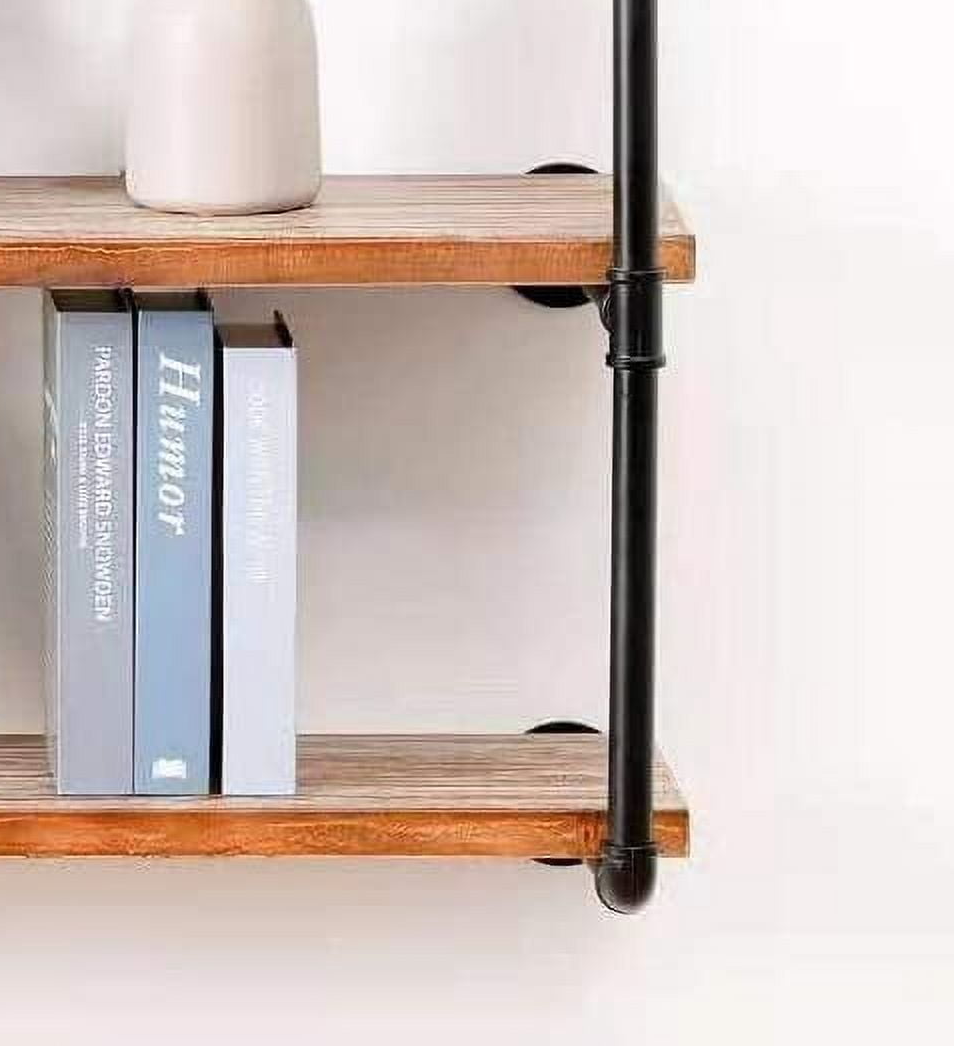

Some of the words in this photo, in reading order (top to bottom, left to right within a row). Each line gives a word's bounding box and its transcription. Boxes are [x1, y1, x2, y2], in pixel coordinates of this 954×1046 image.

[92, 345, 113, 428] PARDON
[92, 432, 113, 517] EDWARD
[158, 352, 201, 536] Humor
[92, 520, 113, 622] SNOWDEN
